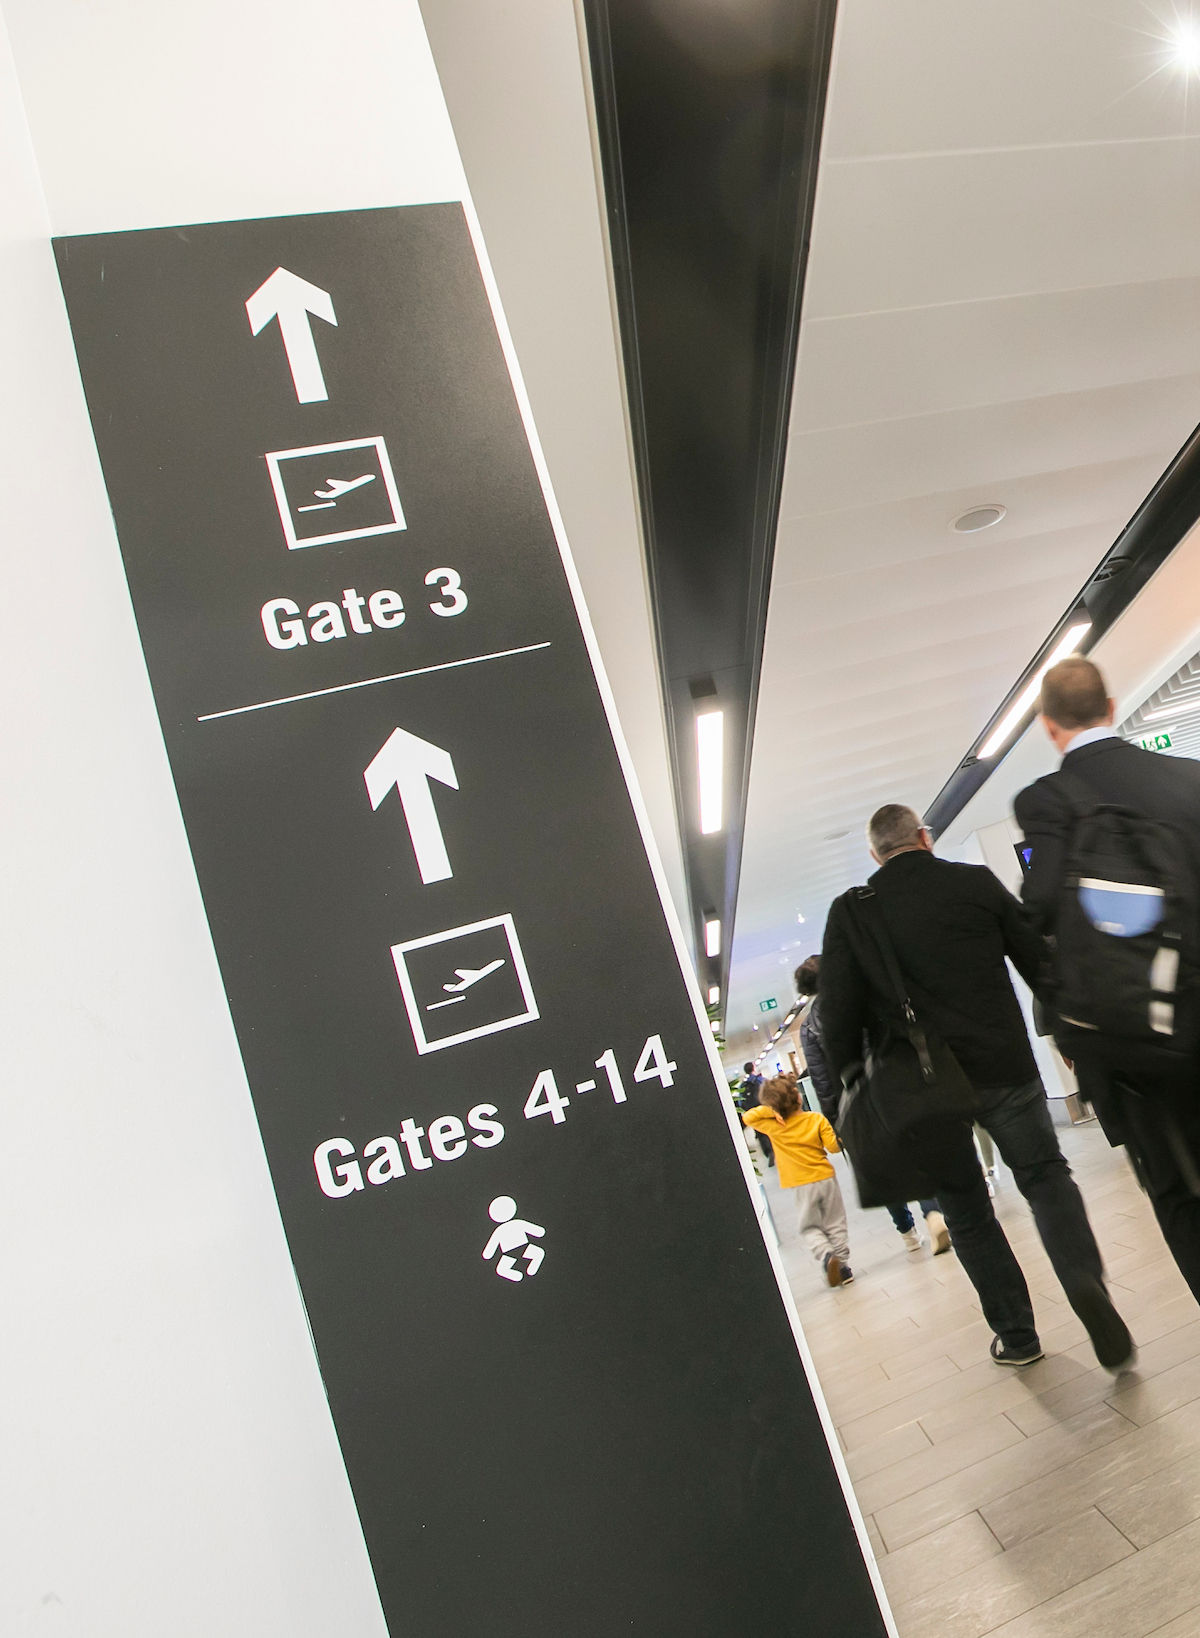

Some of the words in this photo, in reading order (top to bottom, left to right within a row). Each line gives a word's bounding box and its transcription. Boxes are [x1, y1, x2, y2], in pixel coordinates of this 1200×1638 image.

[260, 587, 406, 650] Gate
[423, 567, 468, 618] 3
[314, 1102, 505, 1199] Gates
[522, 1034, 678, 1126] 4-14
